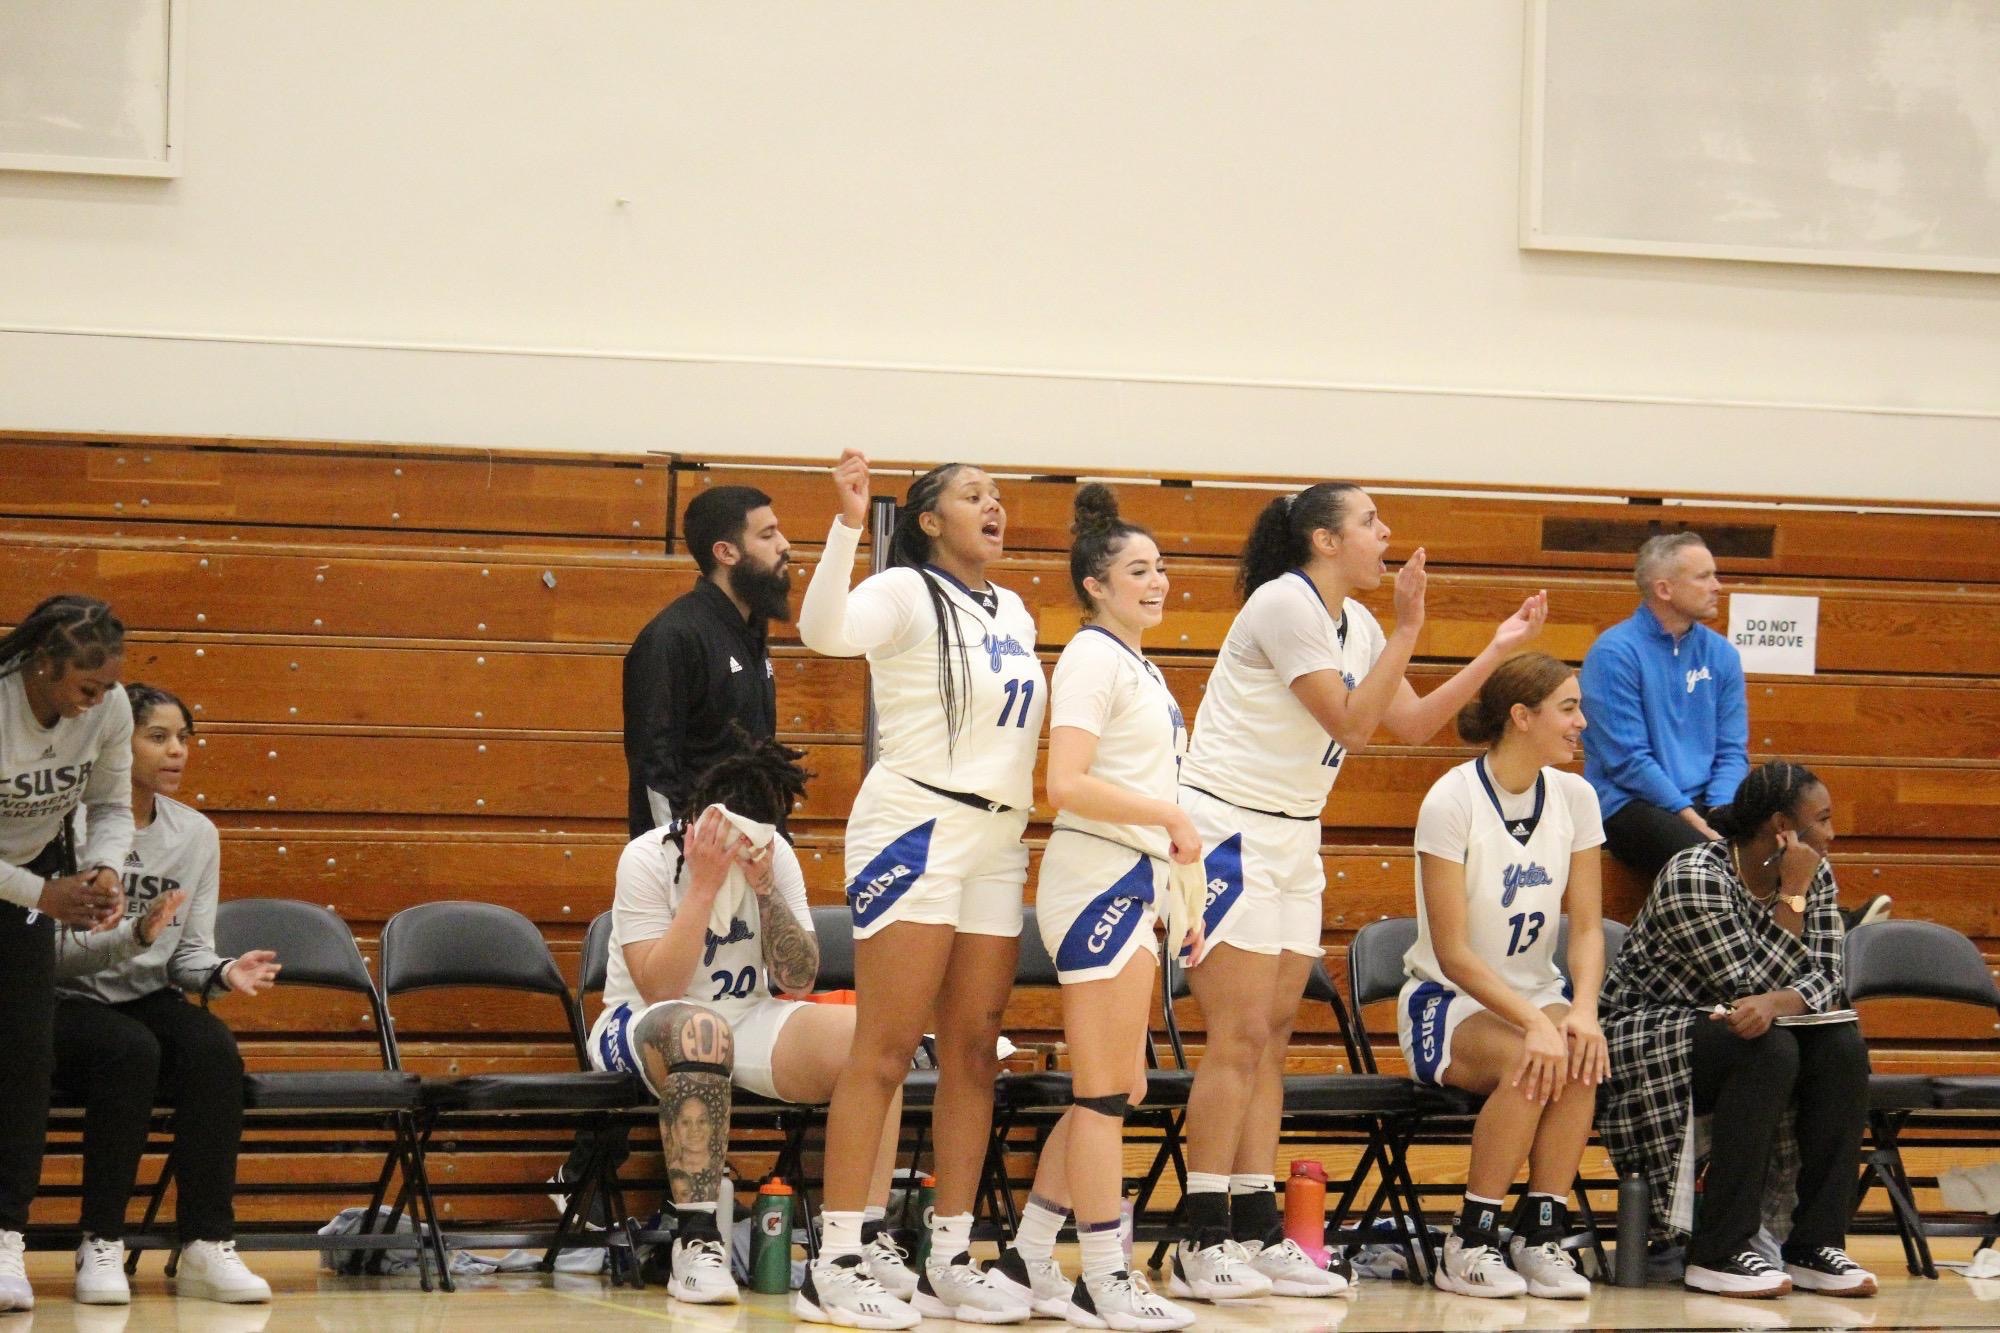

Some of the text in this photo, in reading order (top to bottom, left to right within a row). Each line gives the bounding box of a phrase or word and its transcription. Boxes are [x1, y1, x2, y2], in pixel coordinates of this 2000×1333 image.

[1735, 633, 1804, 648] SIT ABOVE
[1746, 619, 1797, 633] DO NOT
[996, 678, 1035, 729] 11
[855, 864, 912, 914] CSUSB
[1087, 895, 1139, 954] CSUS
[1506, 911, 1546, 957] 13
[711, 965, 757, 1001] 20
[1421, 996, 1442, 1063] CSUSB
